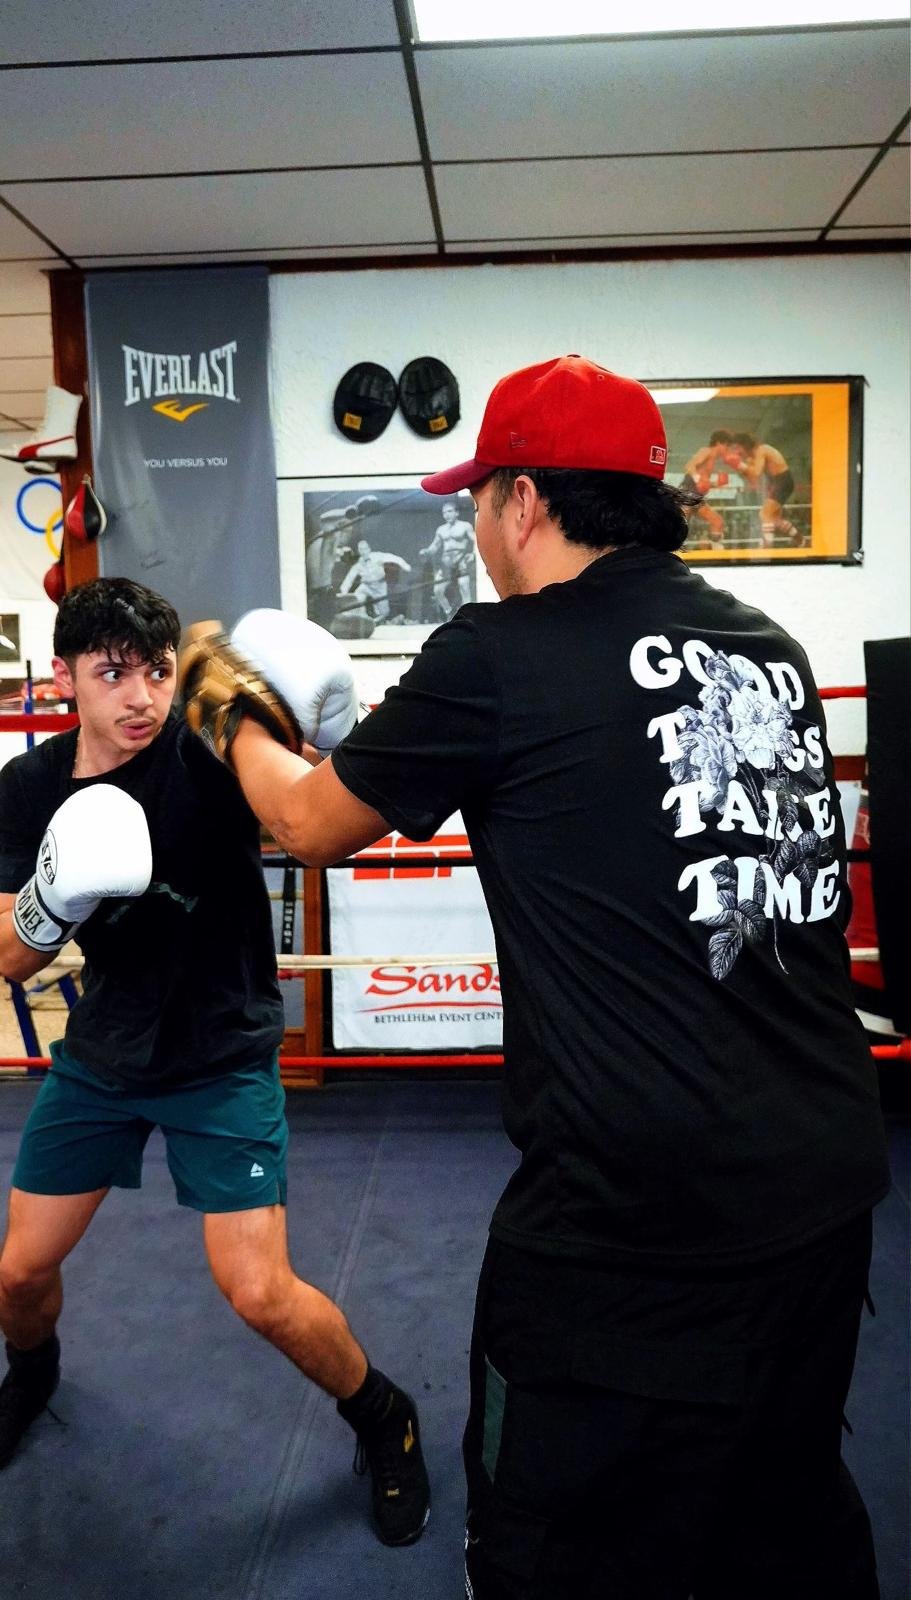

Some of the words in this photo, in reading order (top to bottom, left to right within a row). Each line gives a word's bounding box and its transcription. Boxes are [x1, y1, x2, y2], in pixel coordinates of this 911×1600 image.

[122, 340, 237, 407] EVERLAST
[144, 459, 165, 468] YOU
[167, 458, 205, 468] VERSUS
[206, 456, 228, 466] YOU
[629, 635, 805, 711] GOOD
[647, 711, 824, 772] TGS
[662, 779, 836, 842] TAKE
[677, 854, 841, 924] TIME
[374, 1013, 437, 1024] BETHLEHEM
[439, 1012, 471, 1022] EVENT
